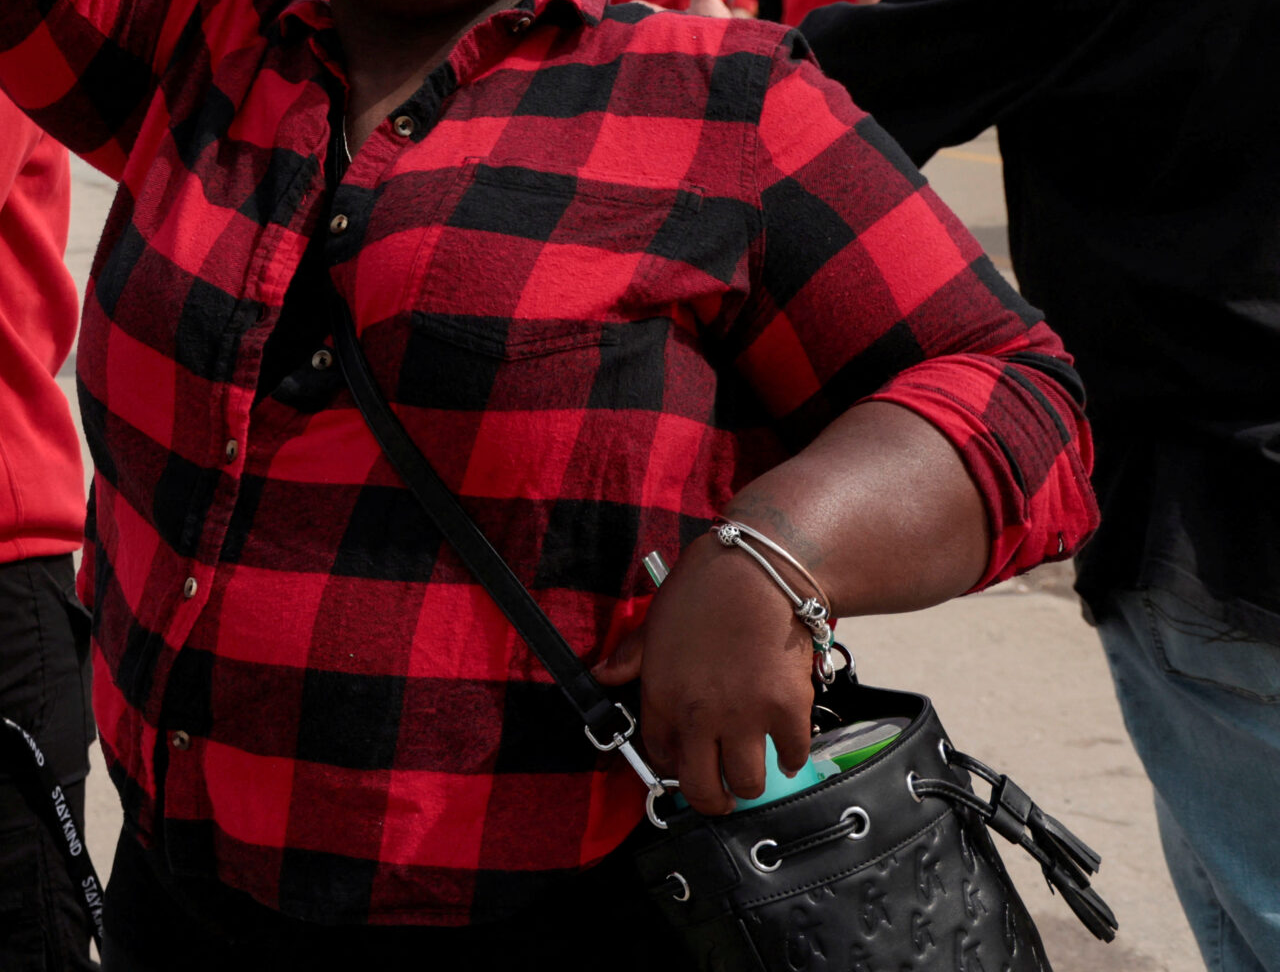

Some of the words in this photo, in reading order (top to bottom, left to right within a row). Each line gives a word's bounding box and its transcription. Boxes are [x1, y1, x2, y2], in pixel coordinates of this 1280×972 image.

[52, 785, 71, 822] STAY
[62, 818, 82, 856] KIND
[81, 876, 103, 908] STAY
